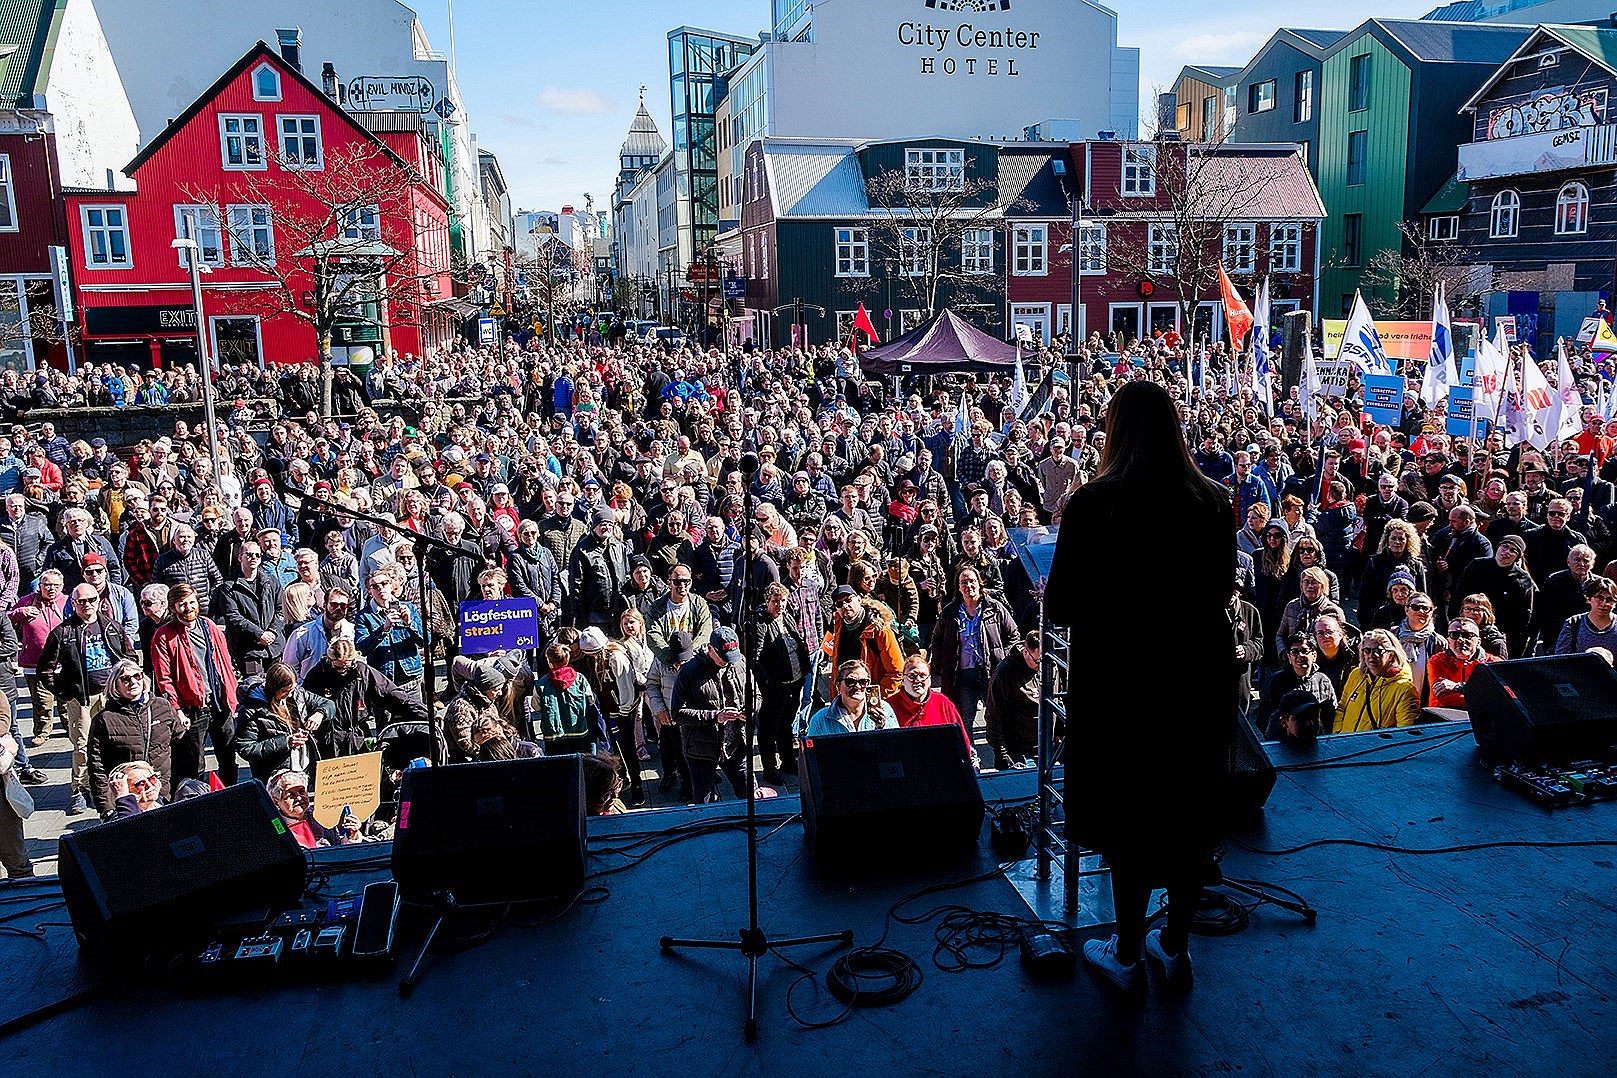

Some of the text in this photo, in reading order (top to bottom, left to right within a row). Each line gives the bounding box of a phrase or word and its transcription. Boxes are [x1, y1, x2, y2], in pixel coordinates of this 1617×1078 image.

[898, 22, 1040, 51] City Center
[920, 57, 1019, 76] HOTEL
[367, 82, 388, 96] EVIL
[160, 309, 194, 324] EXIT
[218, 337, 255, 354] EXIT
[464, 609, 533, 624] Lögfestum
[464, 623, 504, 637] strax!
